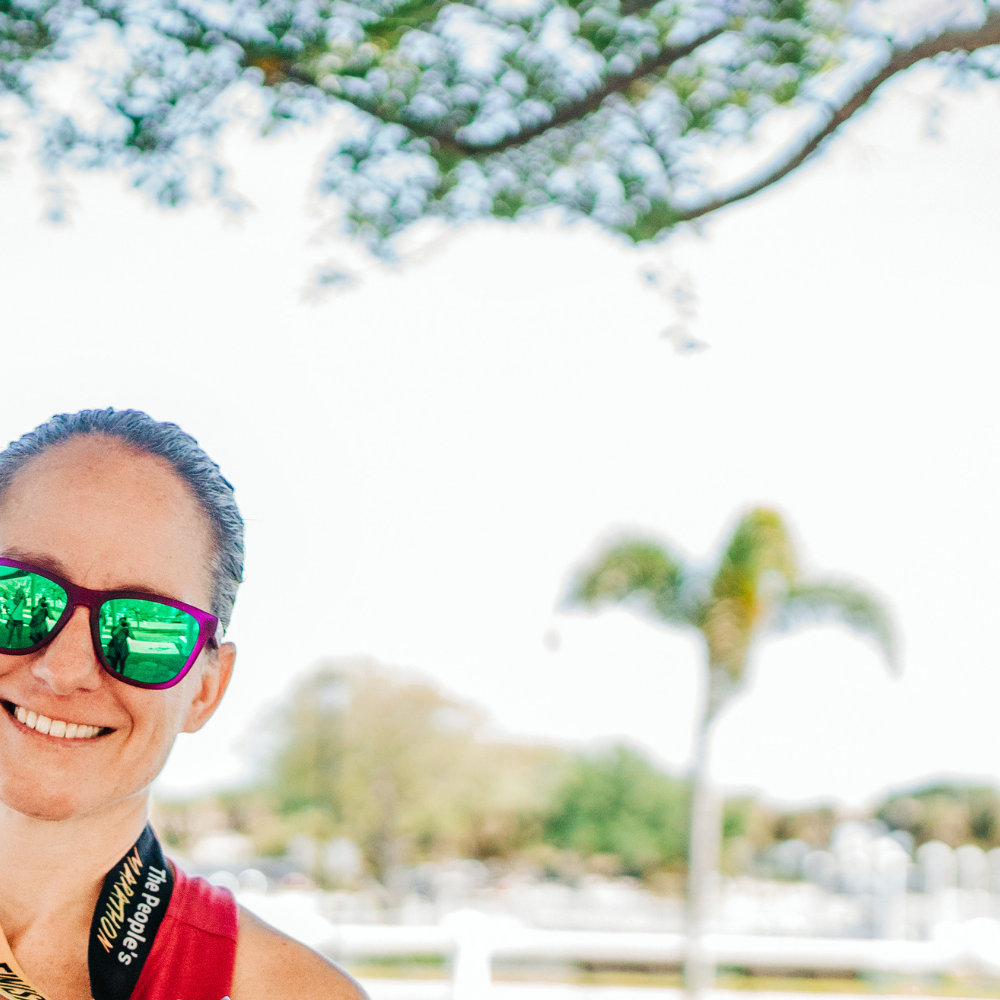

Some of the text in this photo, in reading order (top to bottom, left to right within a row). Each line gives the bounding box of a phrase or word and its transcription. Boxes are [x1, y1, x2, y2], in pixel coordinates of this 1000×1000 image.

[97, 846, 143, 954] MARATHON
[118, 865, 167, 966] The People's
